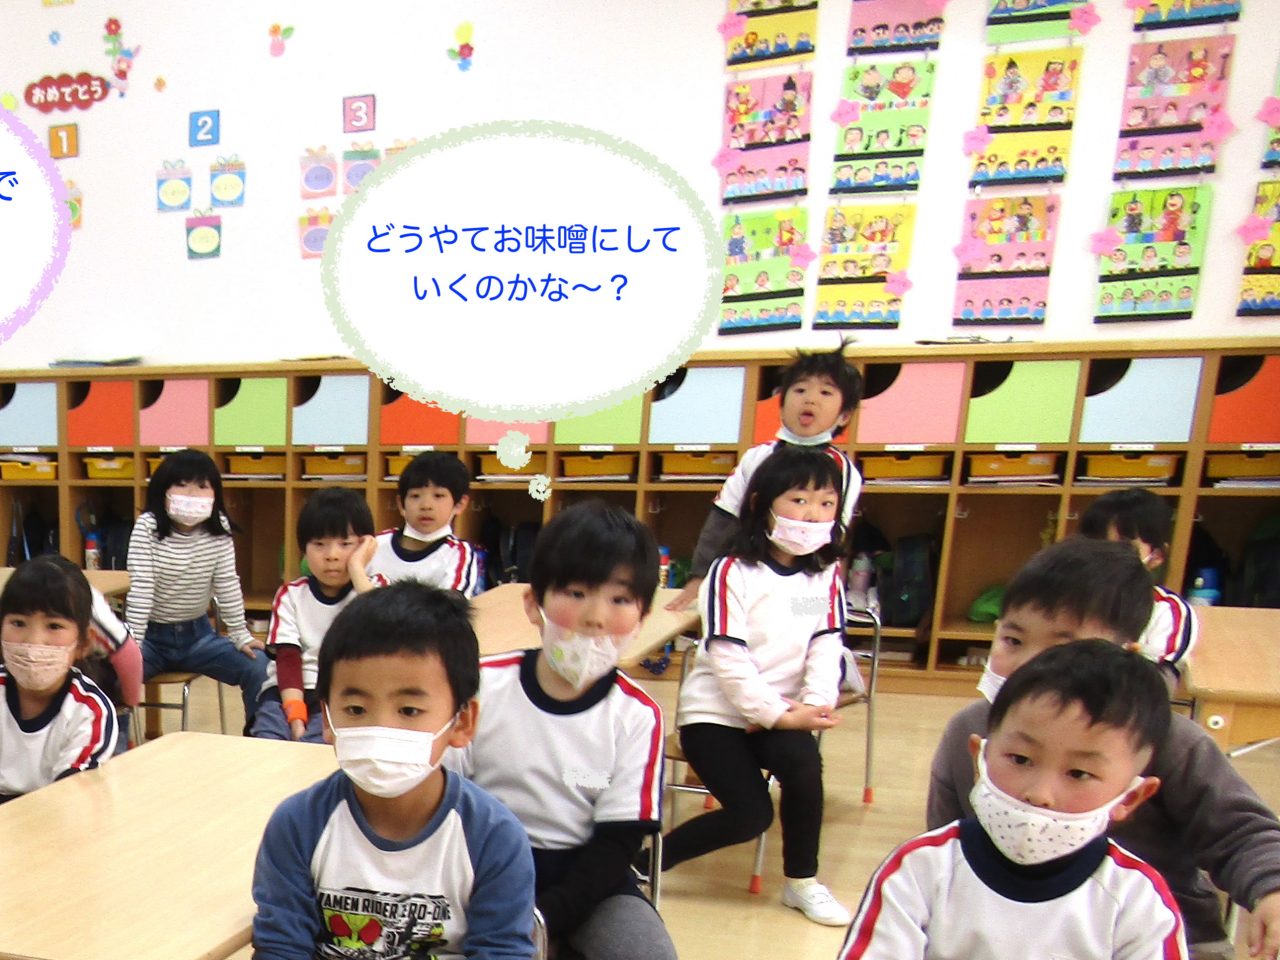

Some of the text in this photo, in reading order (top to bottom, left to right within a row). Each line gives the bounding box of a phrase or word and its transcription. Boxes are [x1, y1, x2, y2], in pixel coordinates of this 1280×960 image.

[32, 80, 103, 104] おめでとう
[351, 102, 368, 126] 3
[196, 116, 214, 141] 2
[57, 131, 69, 155] 1
[361, 898, 398, 919] RIDER
